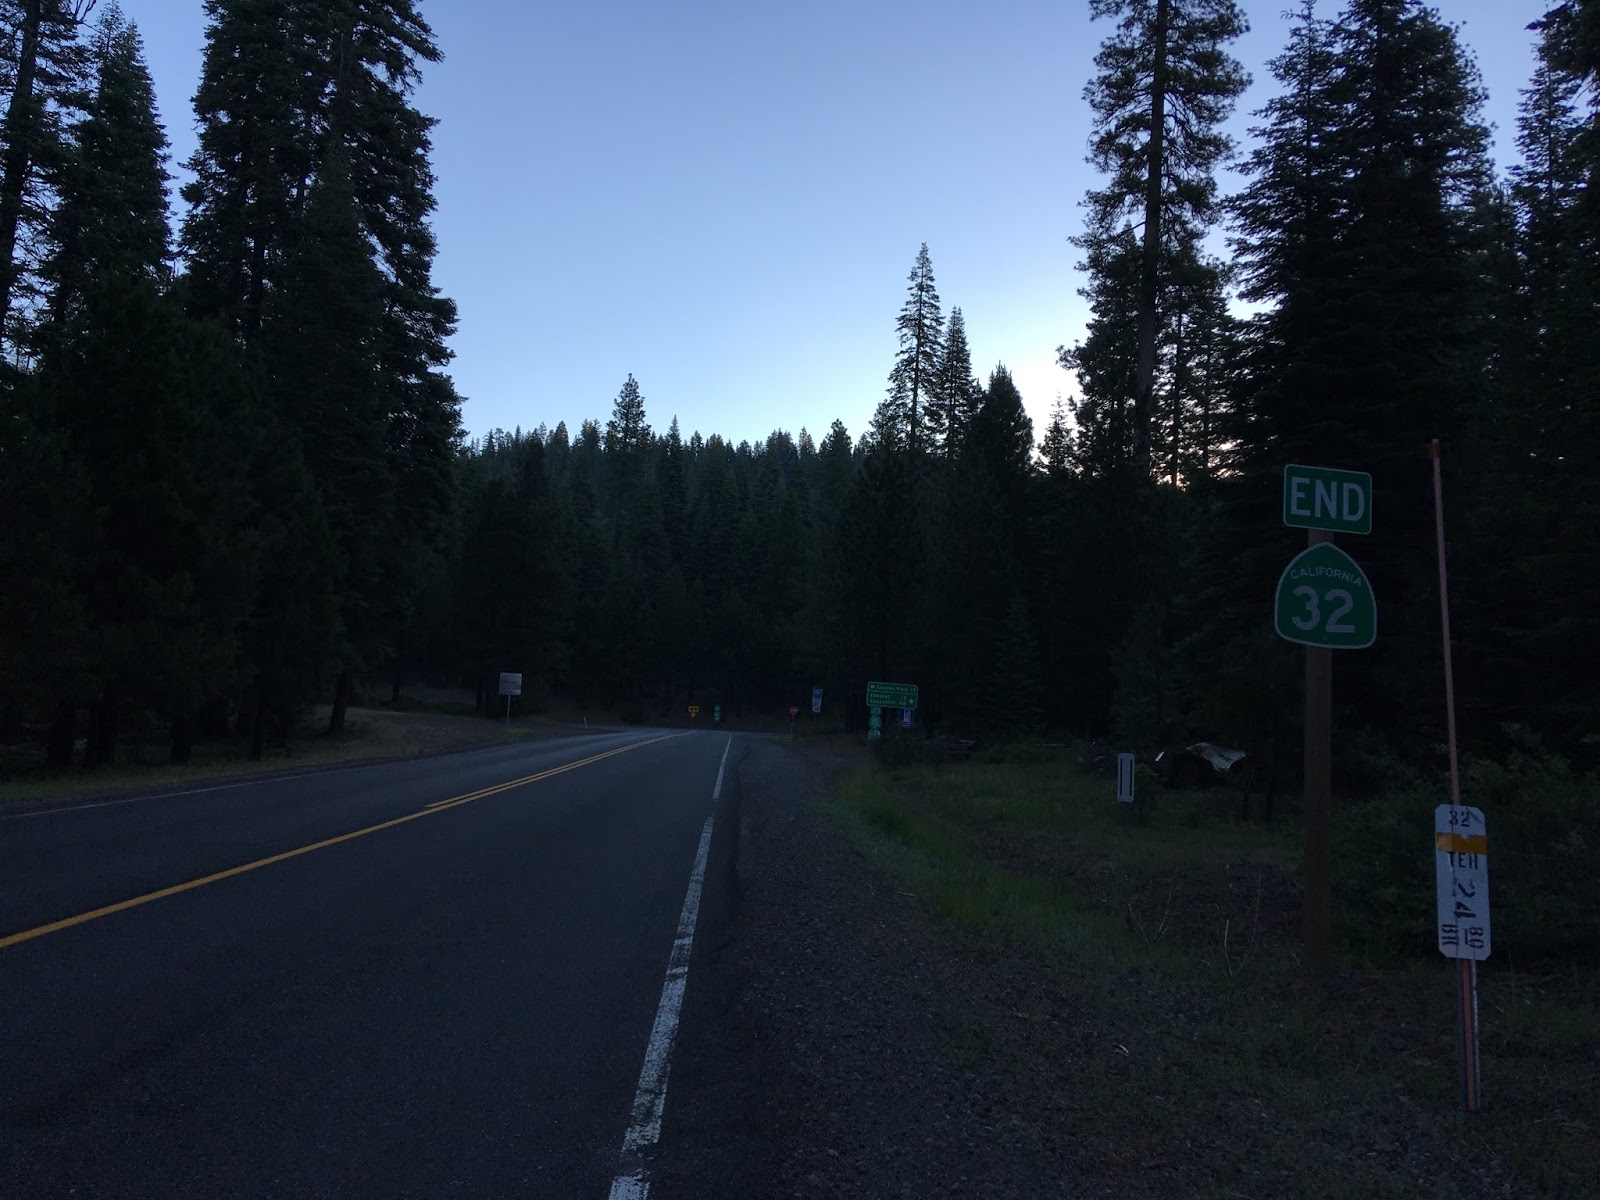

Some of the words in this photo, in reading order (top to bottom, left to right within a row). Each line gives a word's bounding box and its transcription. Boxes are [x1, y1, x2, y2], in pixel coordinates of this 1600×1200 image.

[1291, 476, 1365, 521] END
[1290, 567, 1361, 587] CALIFORNIA
[1291, 585, 1356, 633] 32
[1449, 810, 1470, 827] 32
